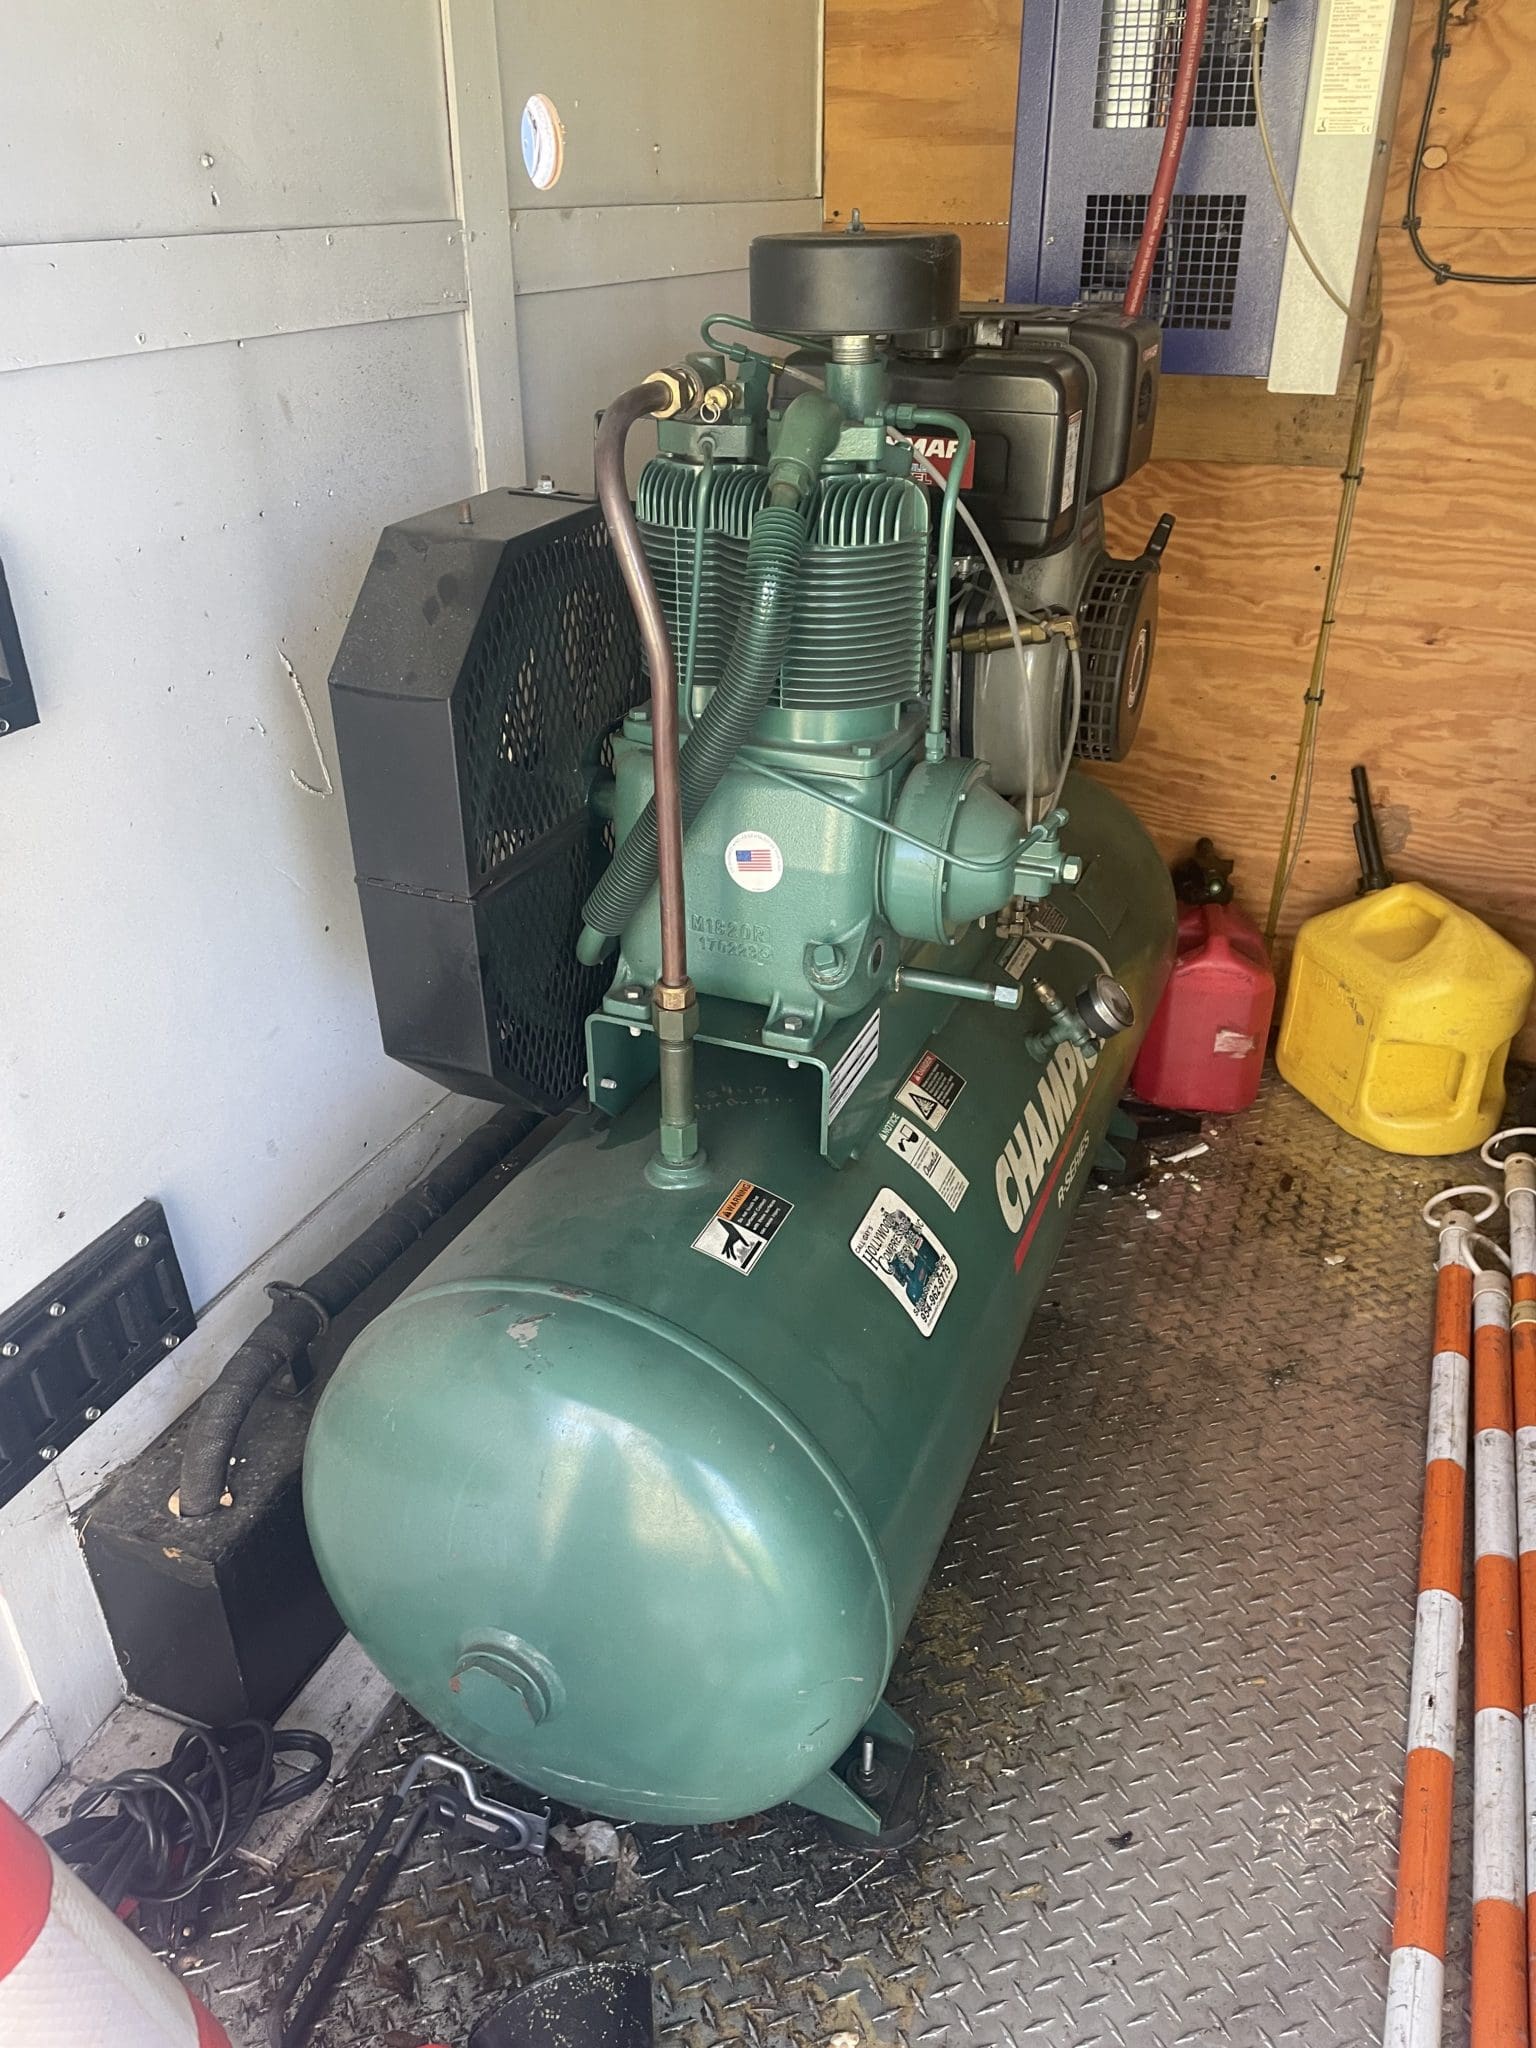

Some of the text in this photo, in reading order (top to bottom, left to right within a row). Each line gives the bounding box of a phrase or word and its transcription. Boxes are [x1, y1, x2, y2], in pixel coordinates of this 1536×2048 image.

[884, 1112, 900, 1138] NOTICE
[726, 1183, 751, 1214] WARNING
[855, 1238, 866, 1254] CALL
[862, 1212, 895, 1271] HOLLYWOOD
[919, 1263, 952, 1323] 954-962-9779
